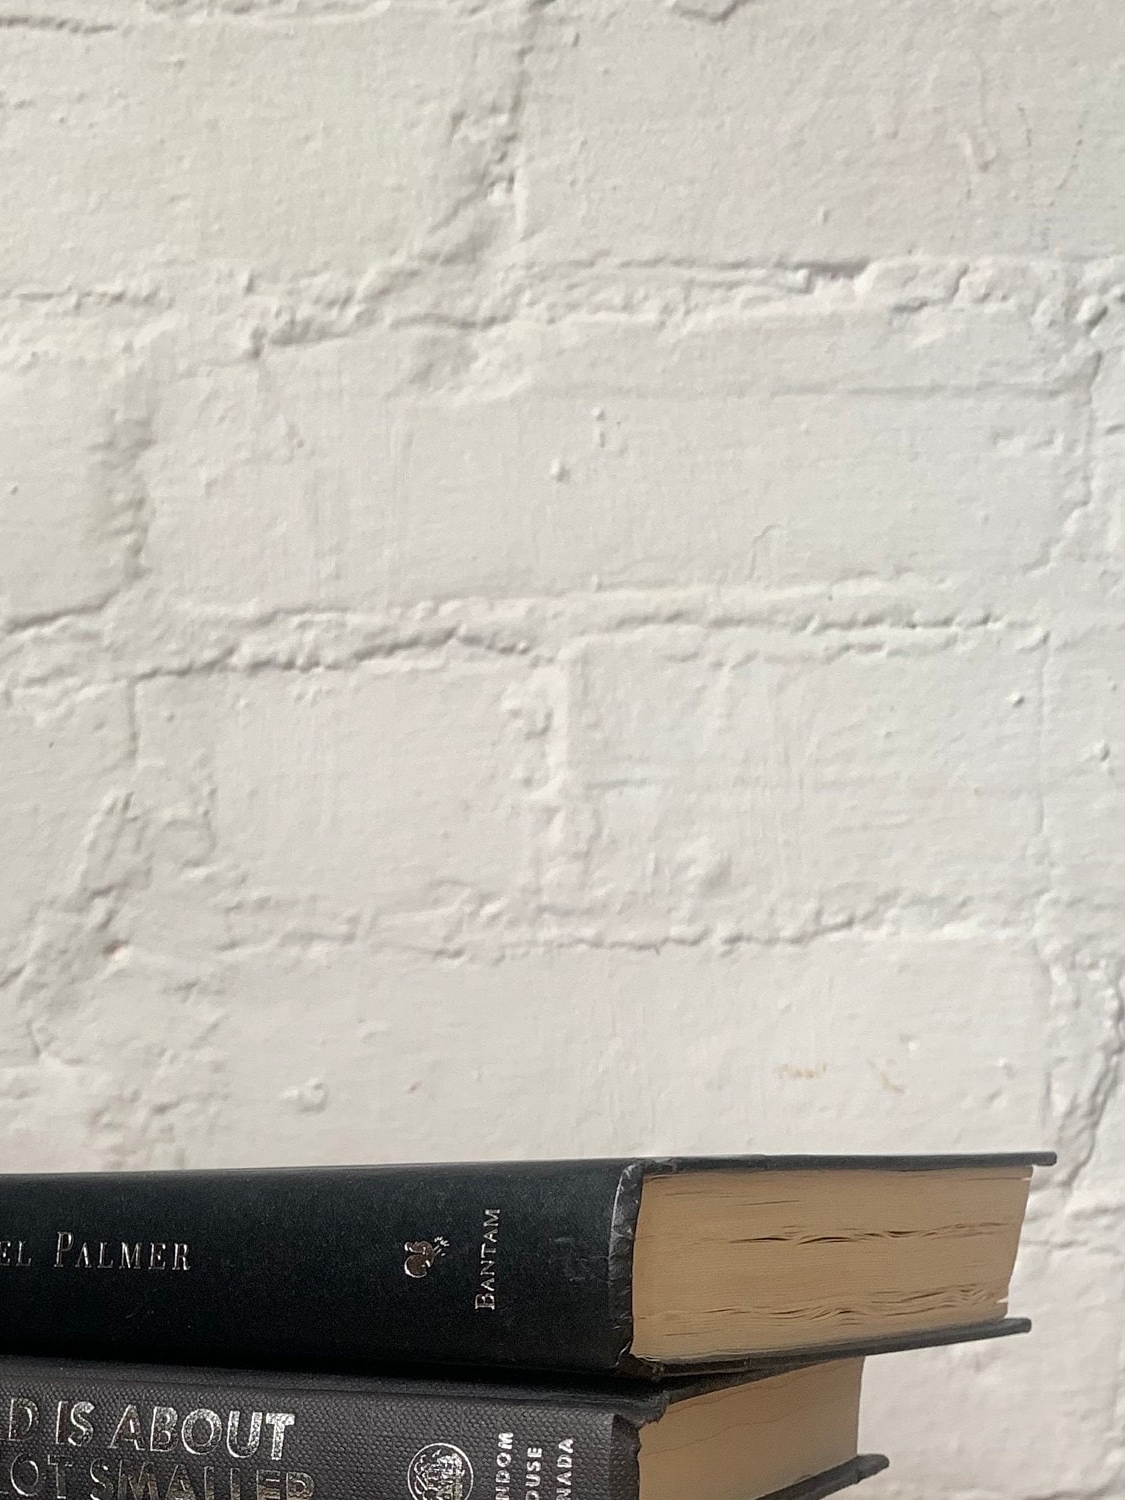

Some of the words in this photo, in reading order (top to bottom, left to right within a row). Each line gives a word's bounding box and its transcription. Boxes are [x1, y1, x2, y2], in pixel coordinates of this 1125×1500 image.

[53, 1231, 191, 1271] PALMER
[475, 1208, 500, 1311] BANTAM
[55, 1400, 96, 1446] IS
[109, 1404, 296, 1461] ABOUT
